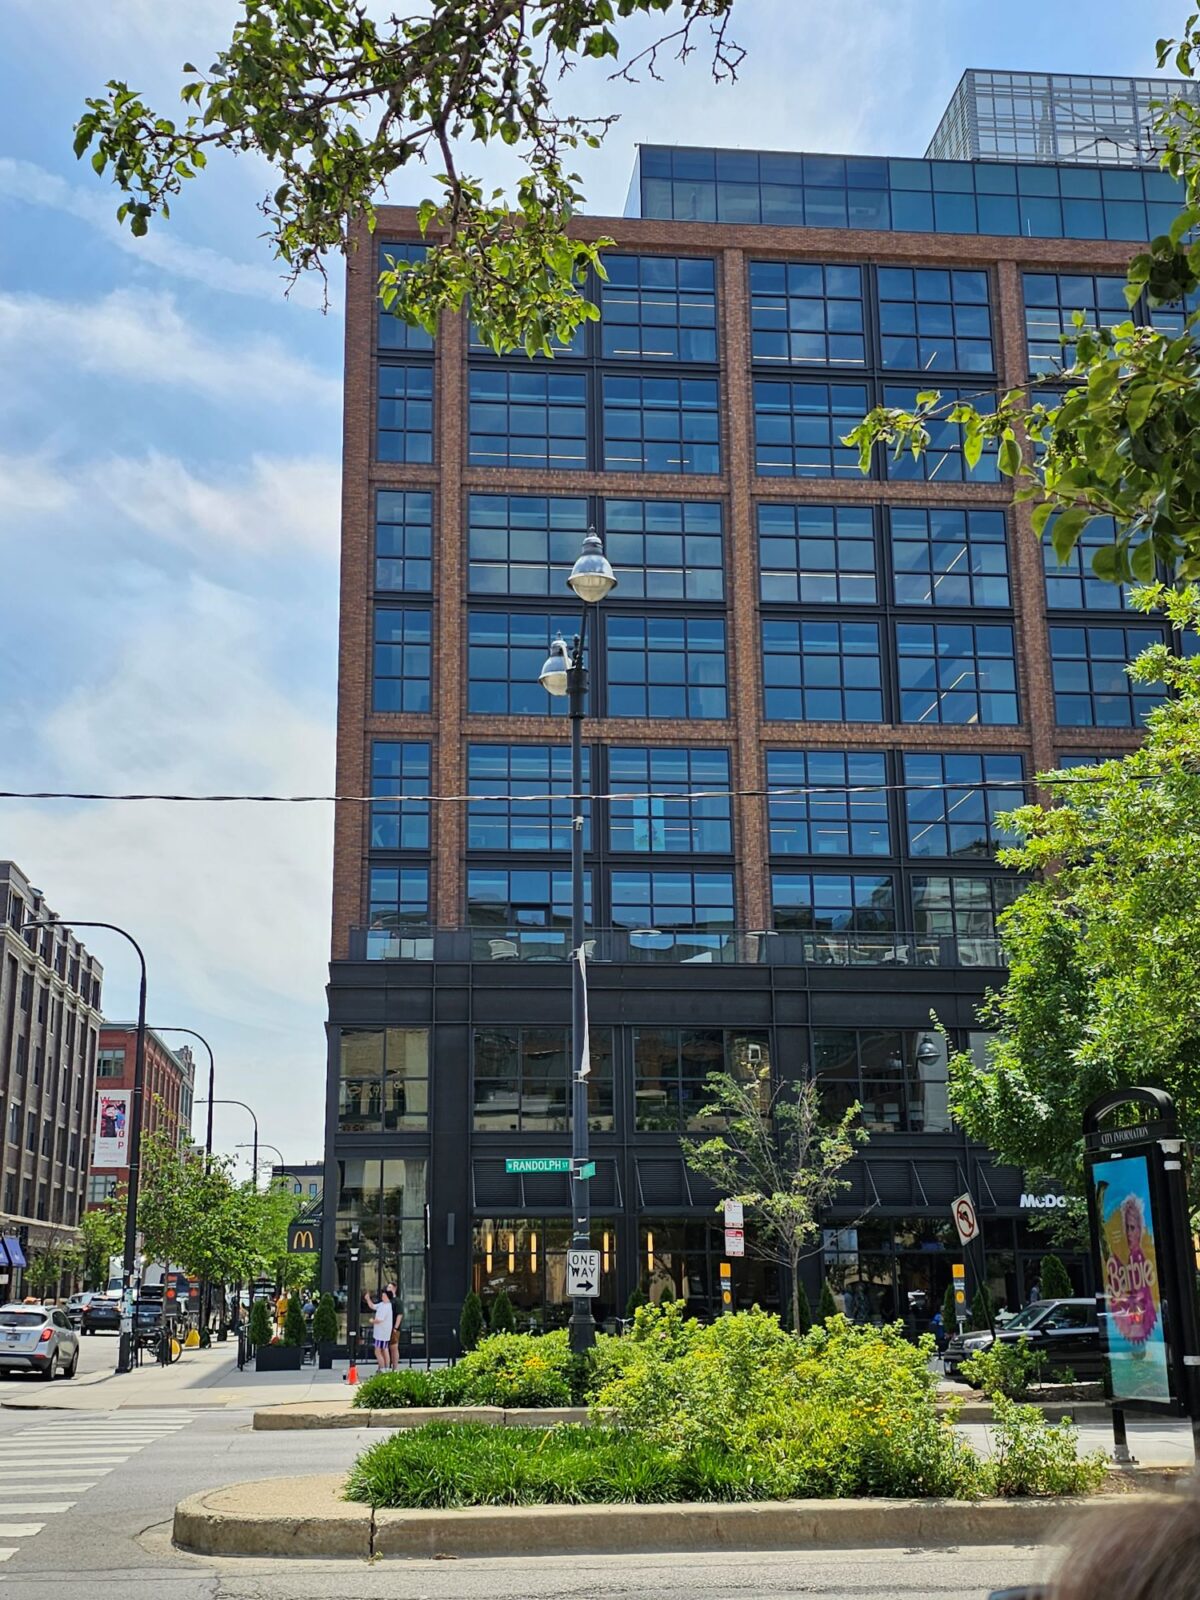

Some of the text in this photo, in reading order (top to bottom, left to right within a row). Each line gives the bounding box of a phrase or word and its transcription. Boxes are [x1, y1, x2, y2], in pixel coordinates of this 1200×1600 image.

[1101, 1126, 1149, 1145] CITY INFORMATION
[512, 1160, 561, 1171] RANDOLPH
[1019, 1194, 1067, 1208] McDo
[572, 1254, 596, 1266] ONE
[571, 1267, 596, 1278] WAY
[1106, 1254, 1156, 1298] Barbie
